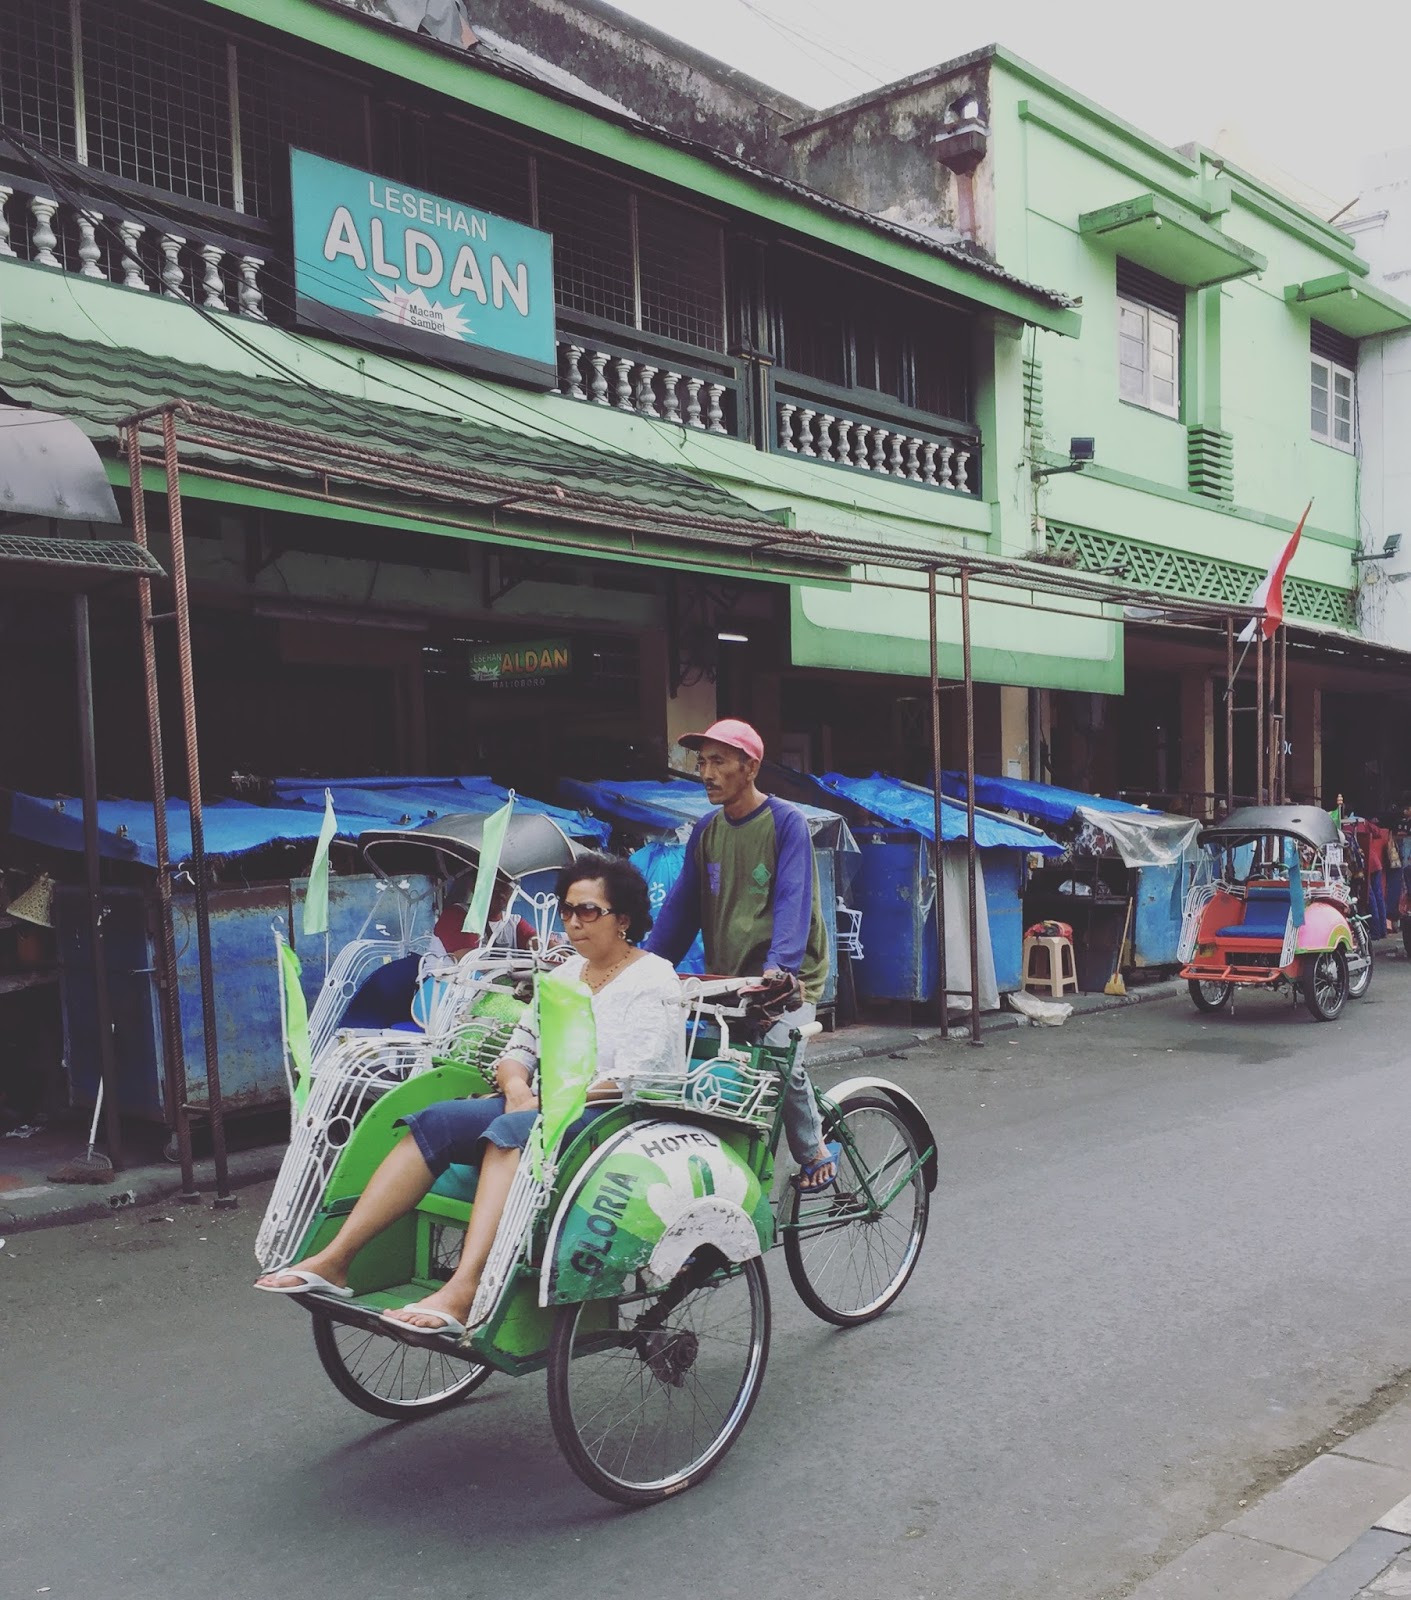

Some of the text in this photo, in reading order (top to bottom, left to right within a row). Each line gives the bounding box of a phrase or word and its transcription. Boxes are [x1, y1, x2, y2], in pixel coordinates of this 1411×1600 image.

[368, 181, 488, 242] LESEHAN
[323, 205, 530, 318] ALDAN
[409, 304, 443, 320] Macam
[470, 653, 501, 663] ESEHAN
[501, 648, 568, 672] ALDAN
[640, 1133, 719, 1158] HOTEL
[570, 1170, 639, 1276] GLORIA
